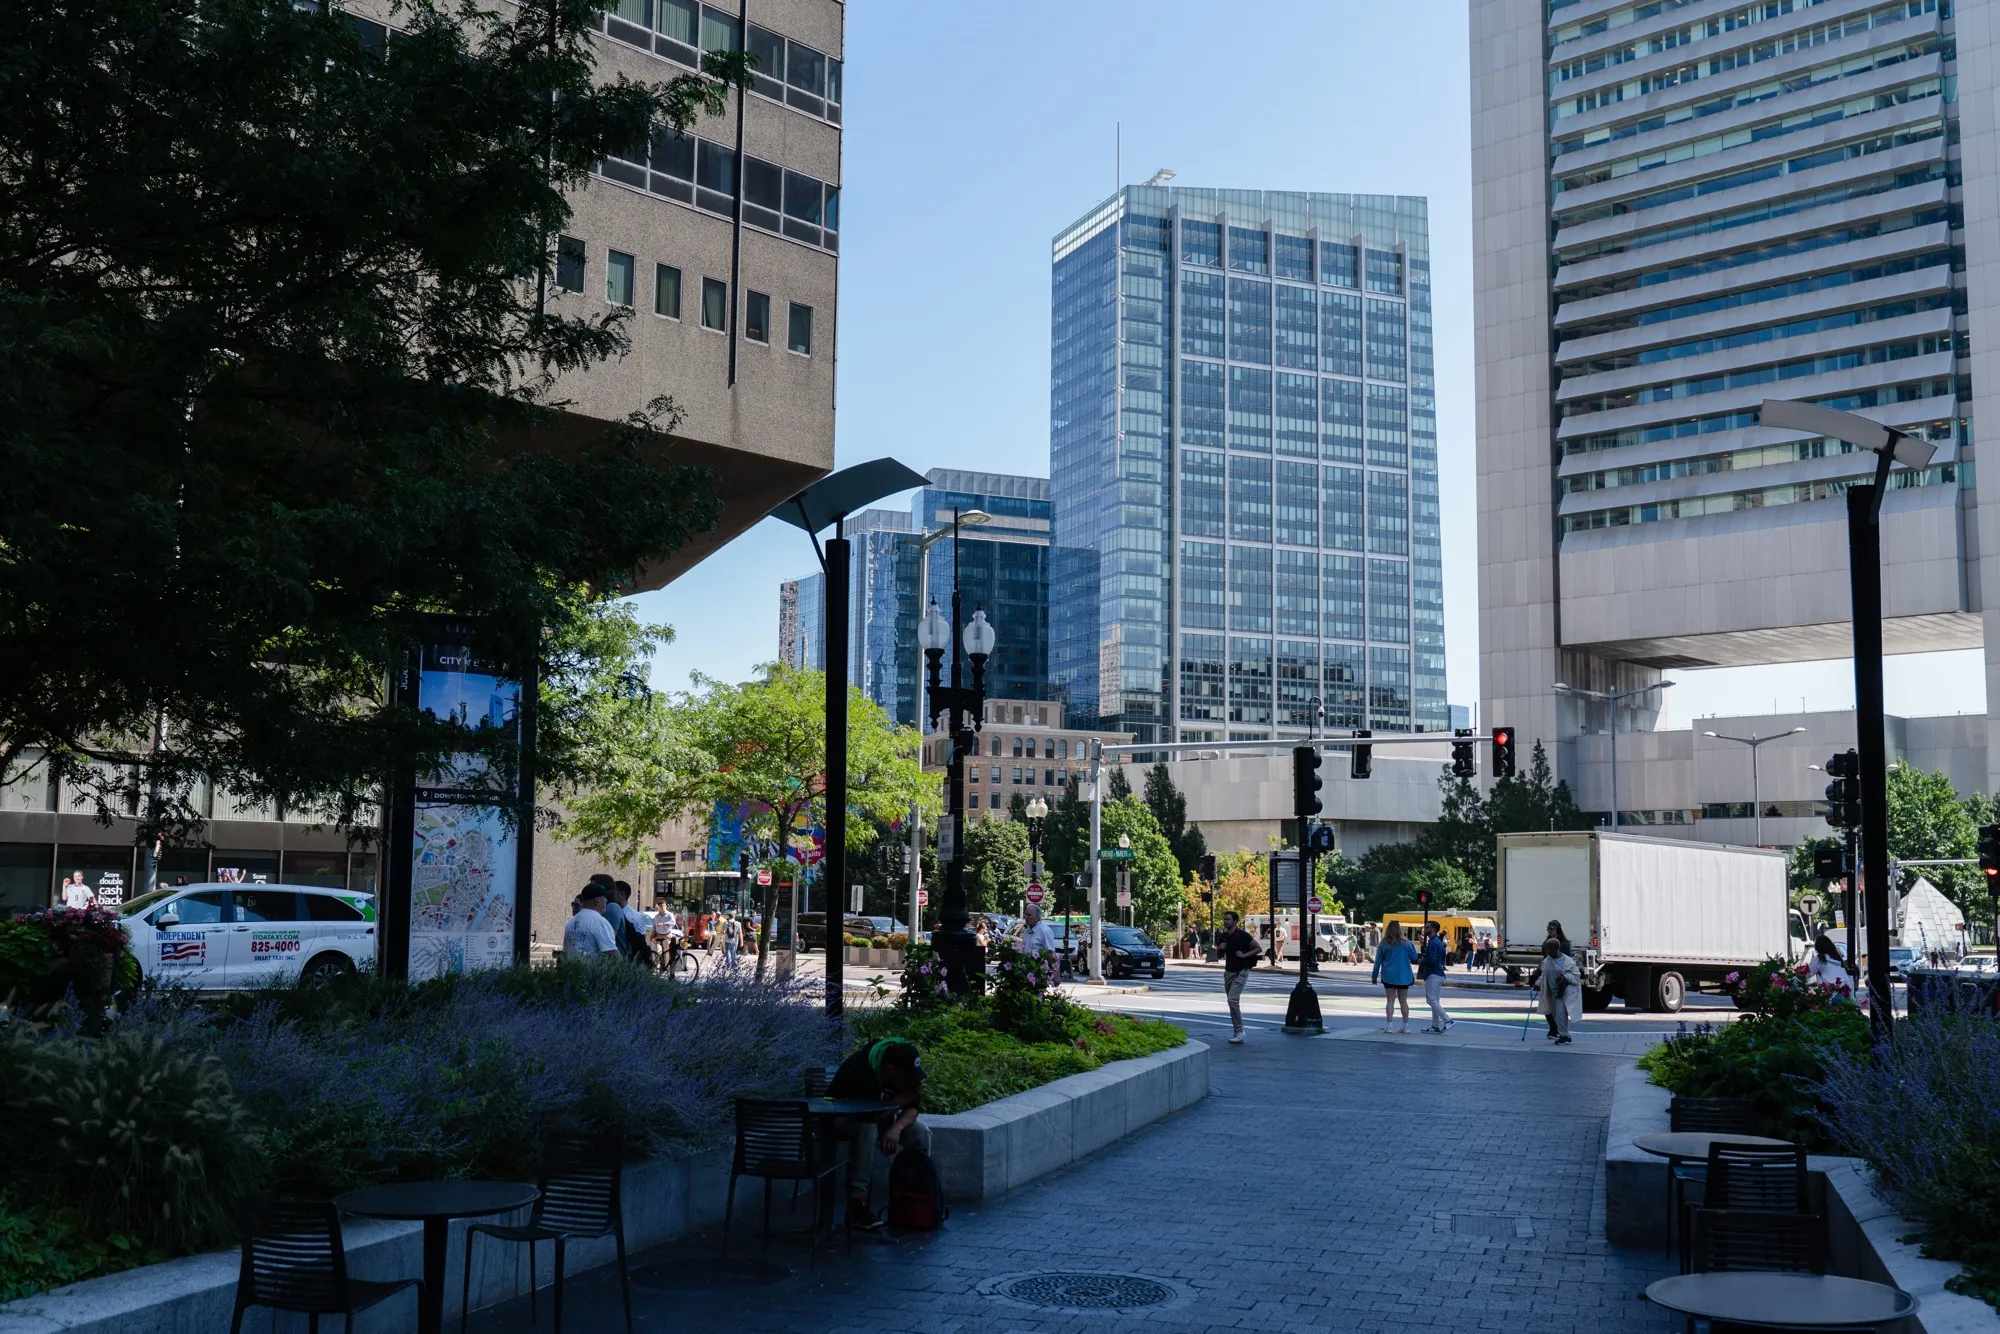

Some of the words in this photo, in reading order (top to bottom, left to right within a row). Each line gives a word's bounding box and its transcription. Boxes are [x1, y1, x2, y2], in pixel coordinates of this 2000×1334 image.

[440, 656, 462, 665] CITY
[99, 877, 124, 886] double
[99, 885, 123, 895] cash
[98, 895, 122, 905] back
[1803, 900, 1816, 912] T
[156, 931, 206, 940] INDEPENDENT
[251, 941, 300, 952] 825-4000
